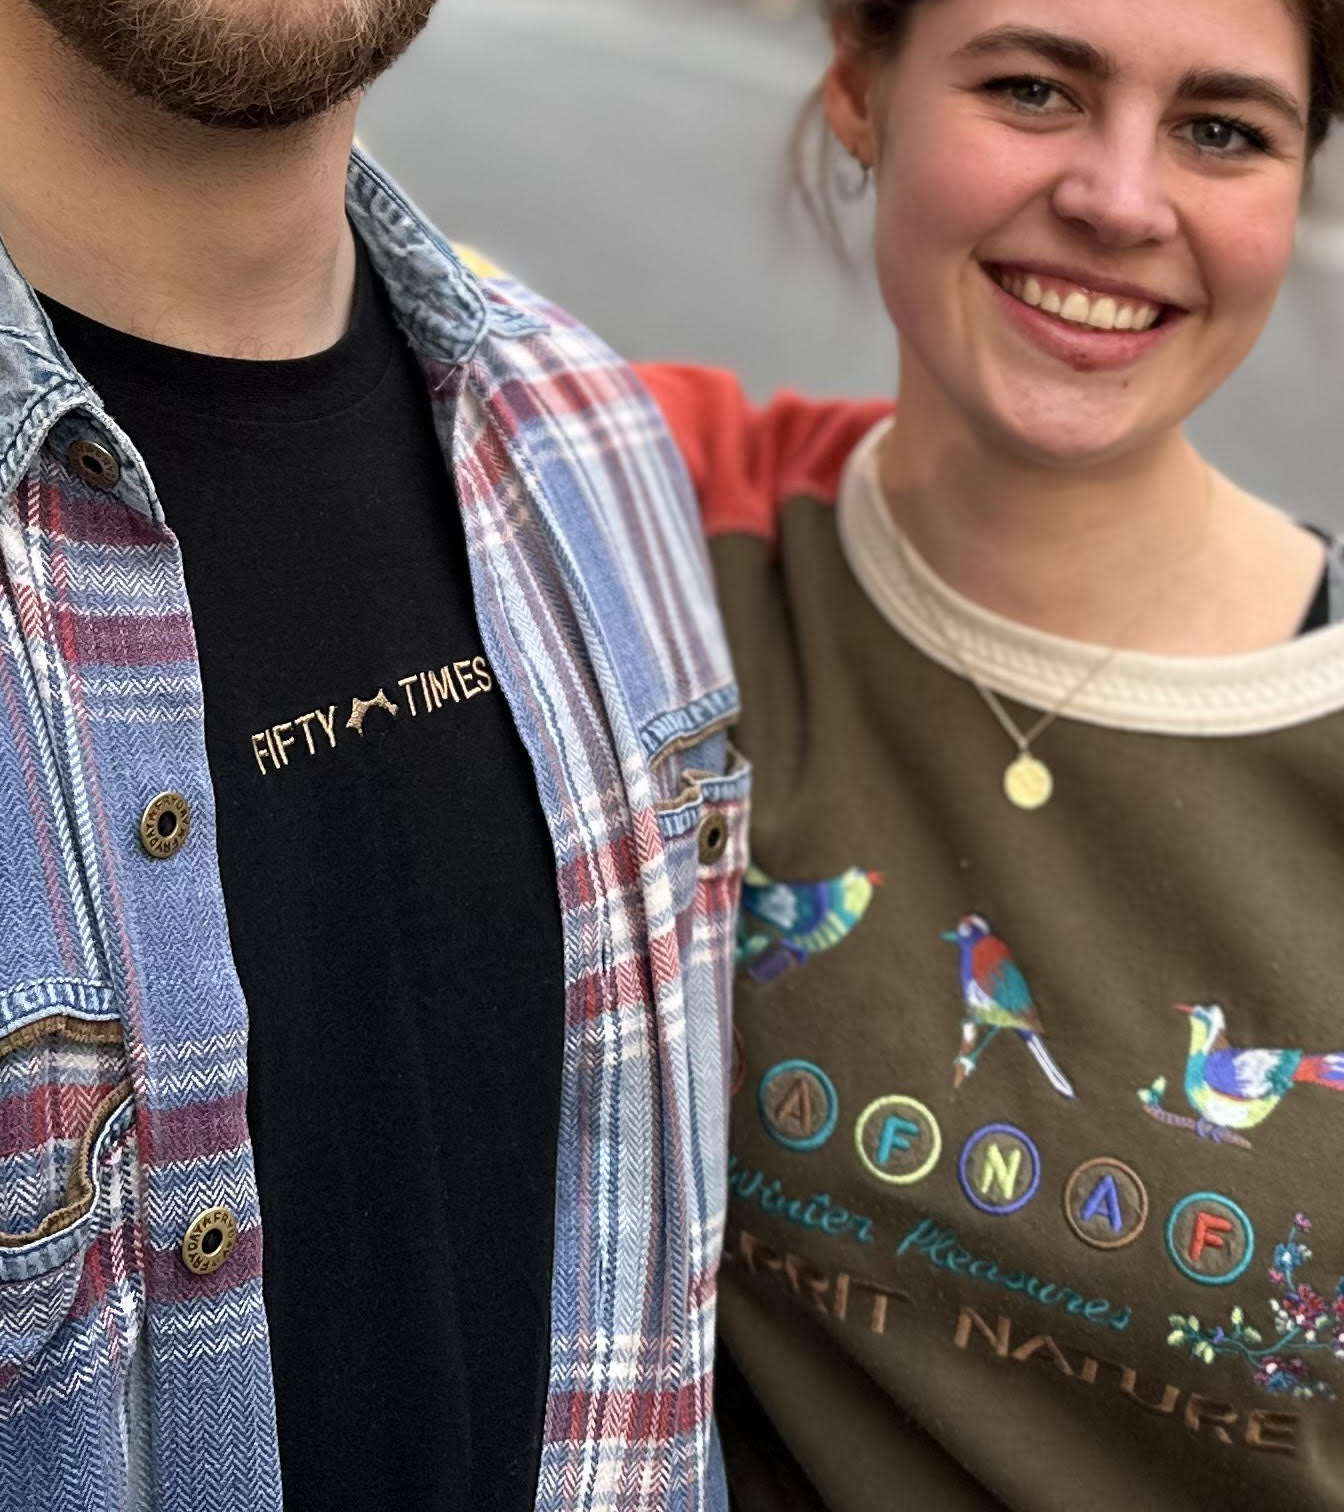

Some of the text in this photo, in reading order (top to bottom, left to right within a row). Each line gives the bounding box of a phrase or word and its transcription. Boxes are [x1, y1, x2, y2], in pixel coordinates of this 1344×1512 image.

[251, 656, 492, 775] FIFTY TIMES
[953, 1305, 1300, 1456] NATURE
